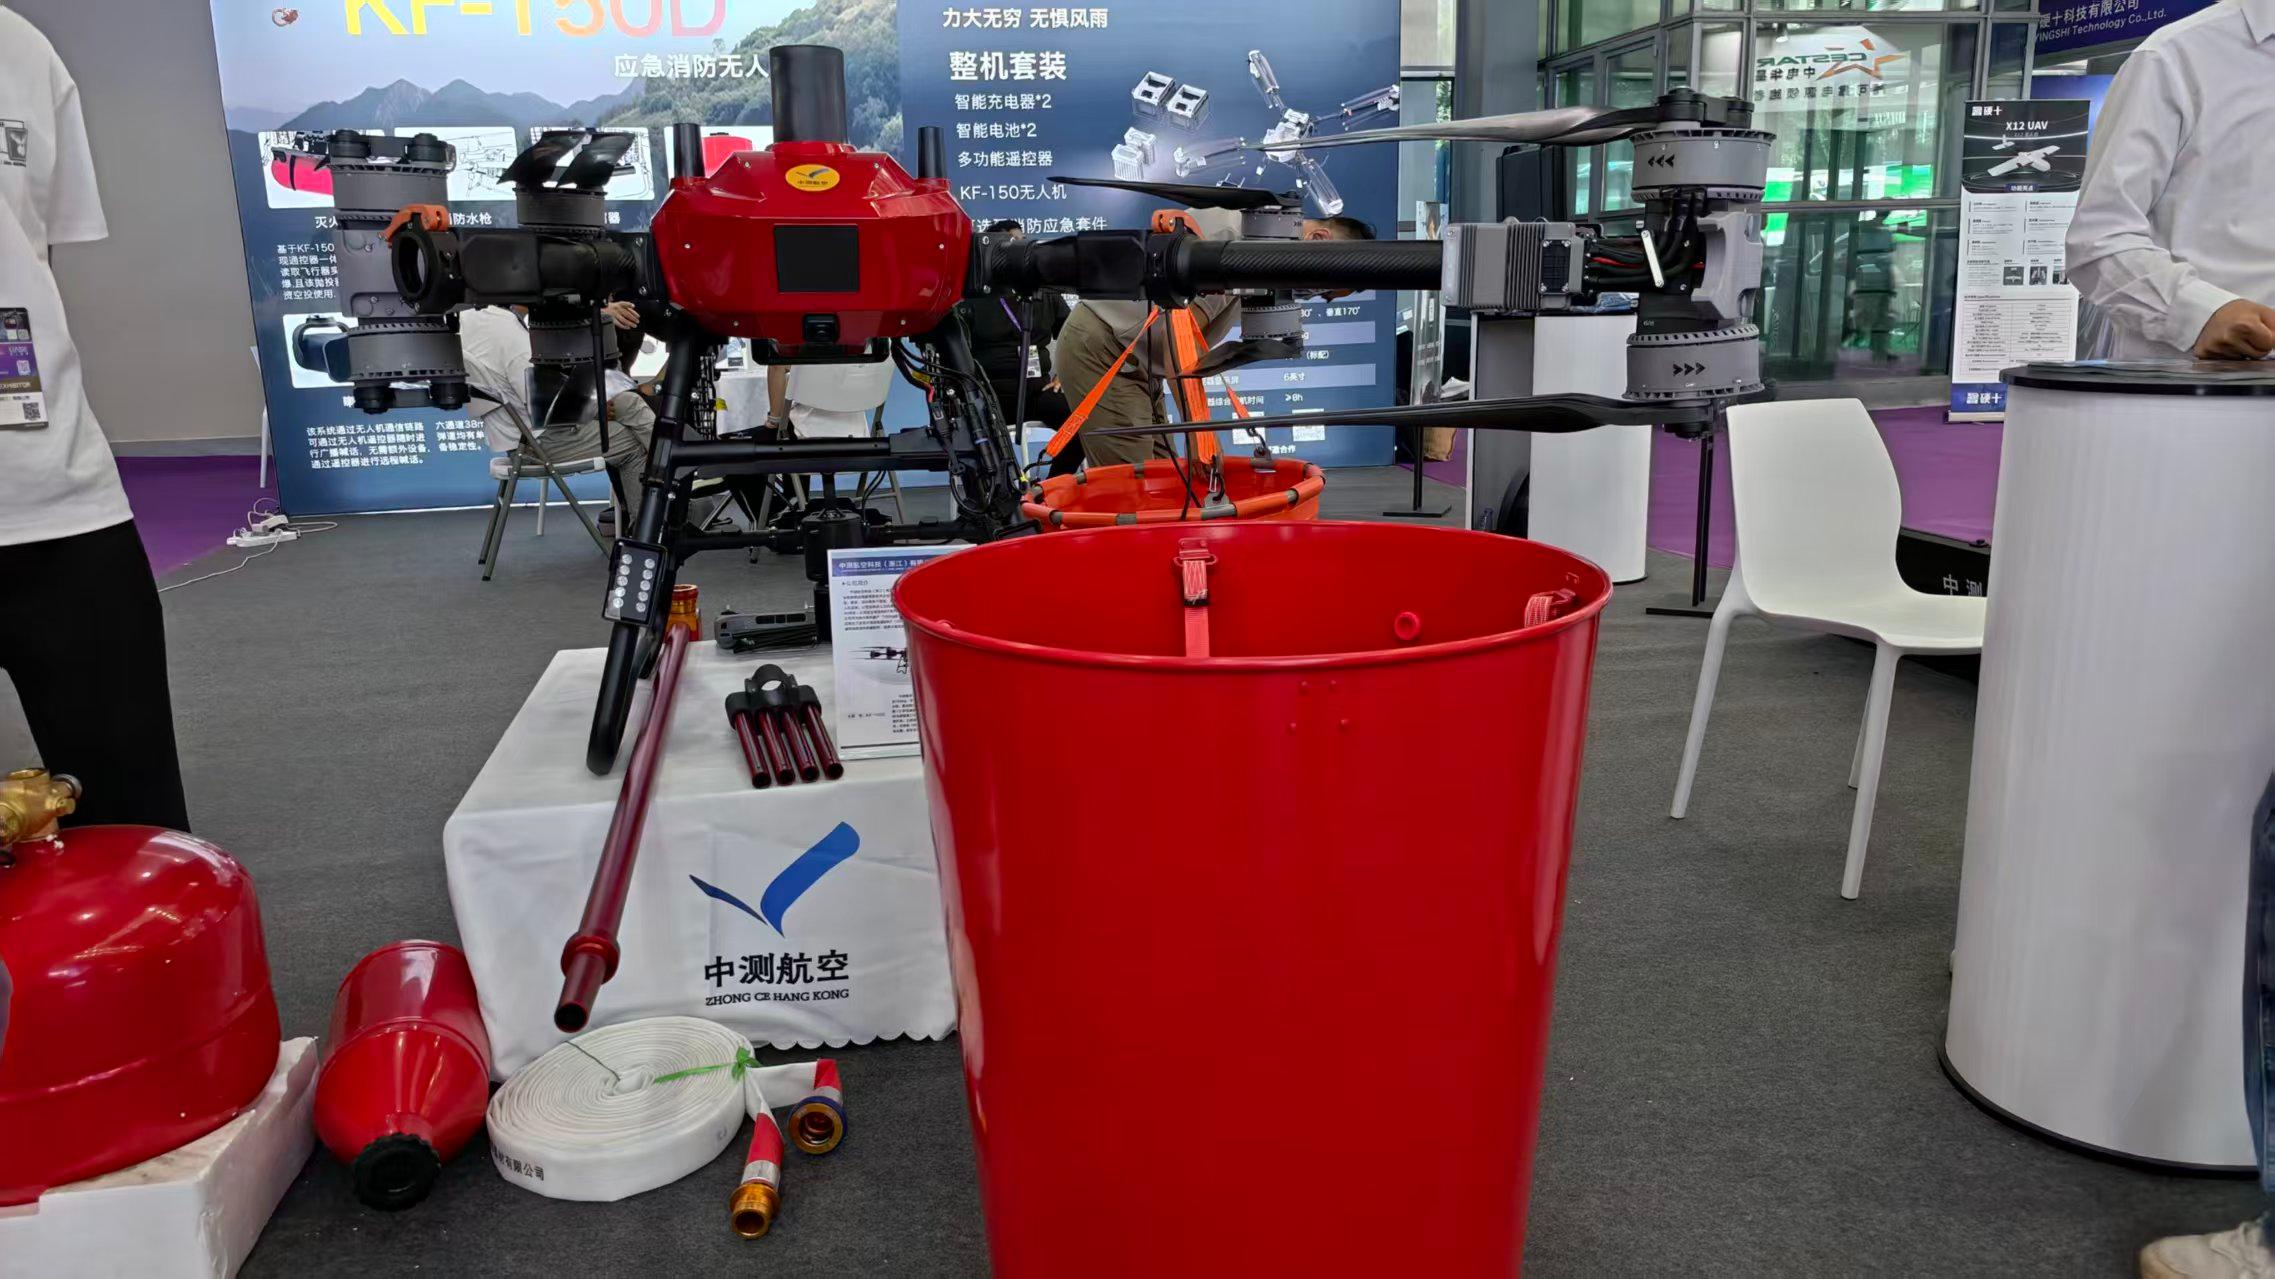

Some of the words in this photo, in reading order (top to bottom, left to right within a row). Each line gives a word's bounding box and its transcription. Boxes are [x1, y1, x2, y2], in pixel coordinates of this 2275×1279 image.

[943, 8, 1022, 29] 力大无穷
[1030, 8, 1109, 29] 无惧风雨
[2073, 17, 2126, 35] Technology
[2128, 8, 2167, 24] Co.,Ltd.
[614, 54, 769, 79] 应急消防无人
[949, 51, 1067, 81] 整机套装
[2006, 121, 2025, 131] X12
[2027, 120, 2048, 131] UAV
[958, 151, 1053, 168] 多功能遥控器
[960, 184, 1067, 200] KF-150无人机
[449, 212, 492, 226] 防水枪
[604, 211, 620, 225] 器
[972, 216, 1108, 234] 选防应急套件
[704, 949, 849, 988] 中测航空
[705, 992, 751, 1007] ZHONG
[754, 991, 771, 1002] CE
[773, 991, 810, 1002] HANG
[813, 989, 850, 1001] KONG
